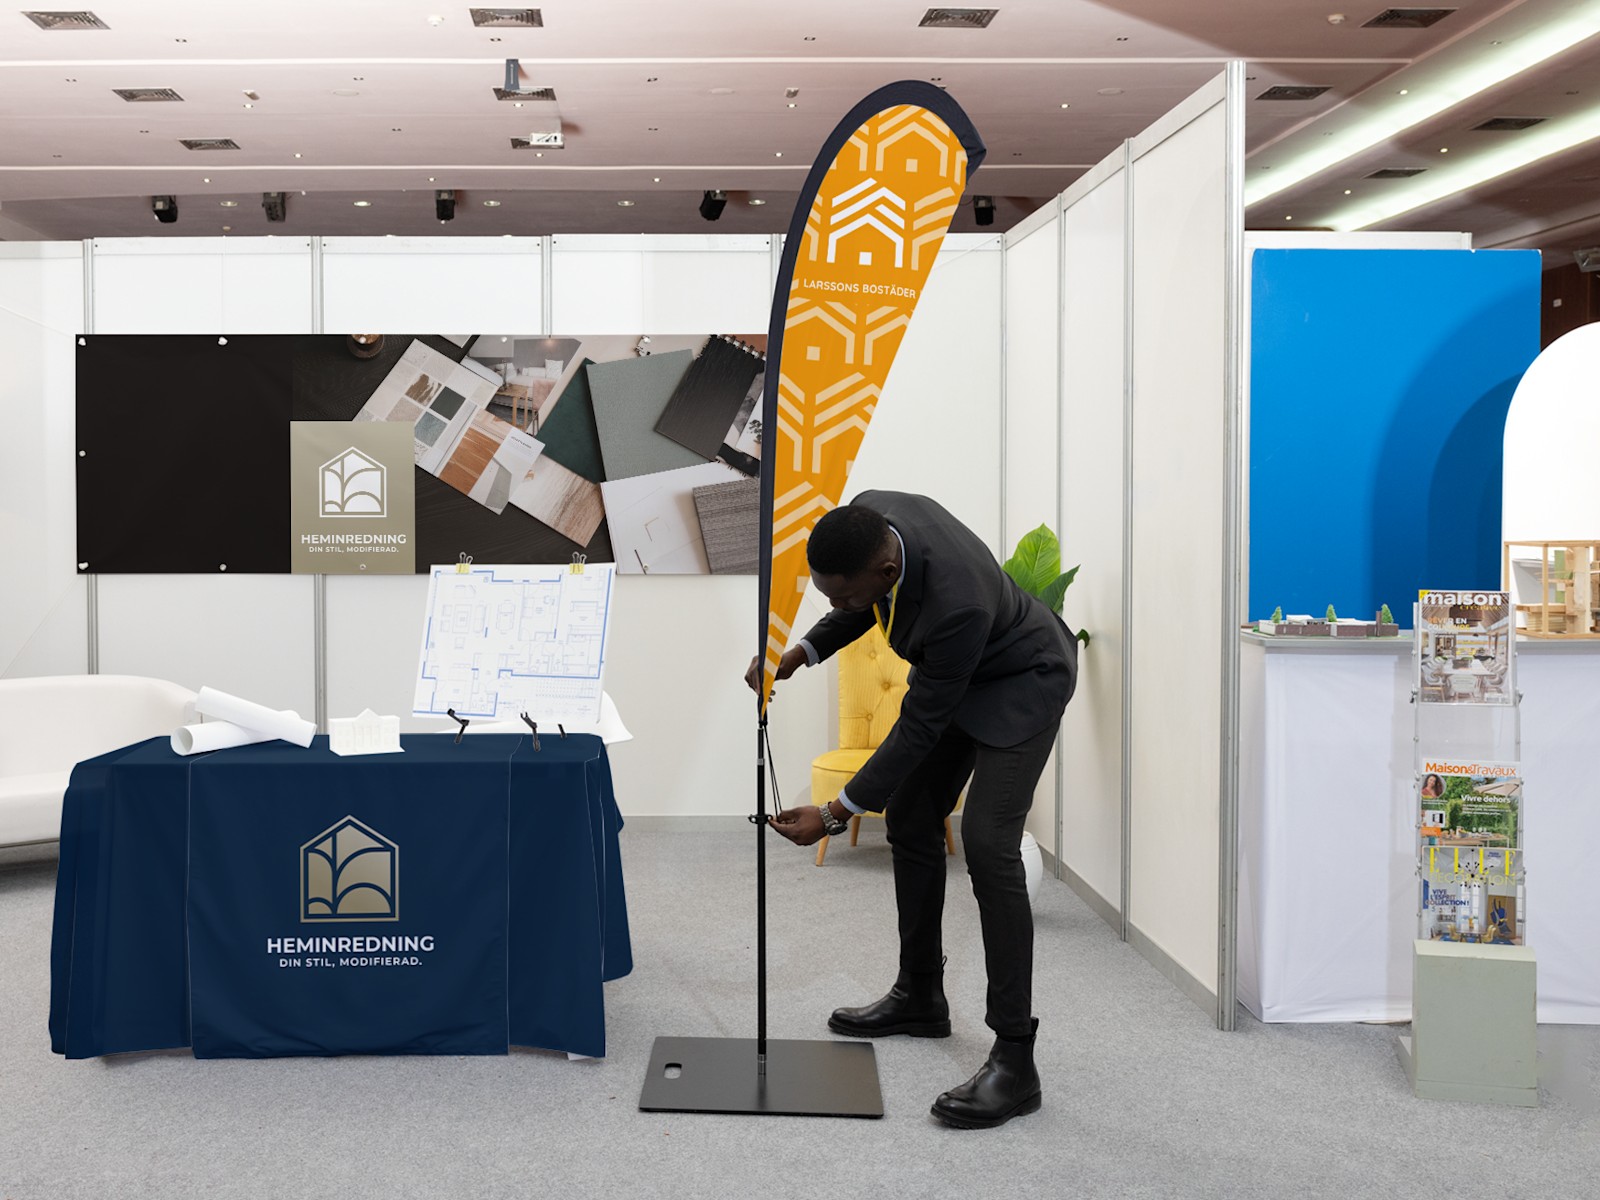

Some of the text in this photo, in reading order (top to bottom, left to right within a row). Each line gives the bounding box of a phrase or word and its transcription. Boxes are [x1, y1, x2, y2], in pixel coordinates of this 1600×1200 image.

[803, 278, 917, 299] LARSSONS BOSTÄDER
[301, 534, 407, 544] HEMINREDNING
[325, 546, 345, 554] STIL,
[1423, 592, 1502, 605] maison
[1461, 794, 1511, 804] Vivre dehors
[267, 936, 435, 953] HEMINREDNING
[279, 956, 423, 968] DIN STIL, MODIFIERAD.
